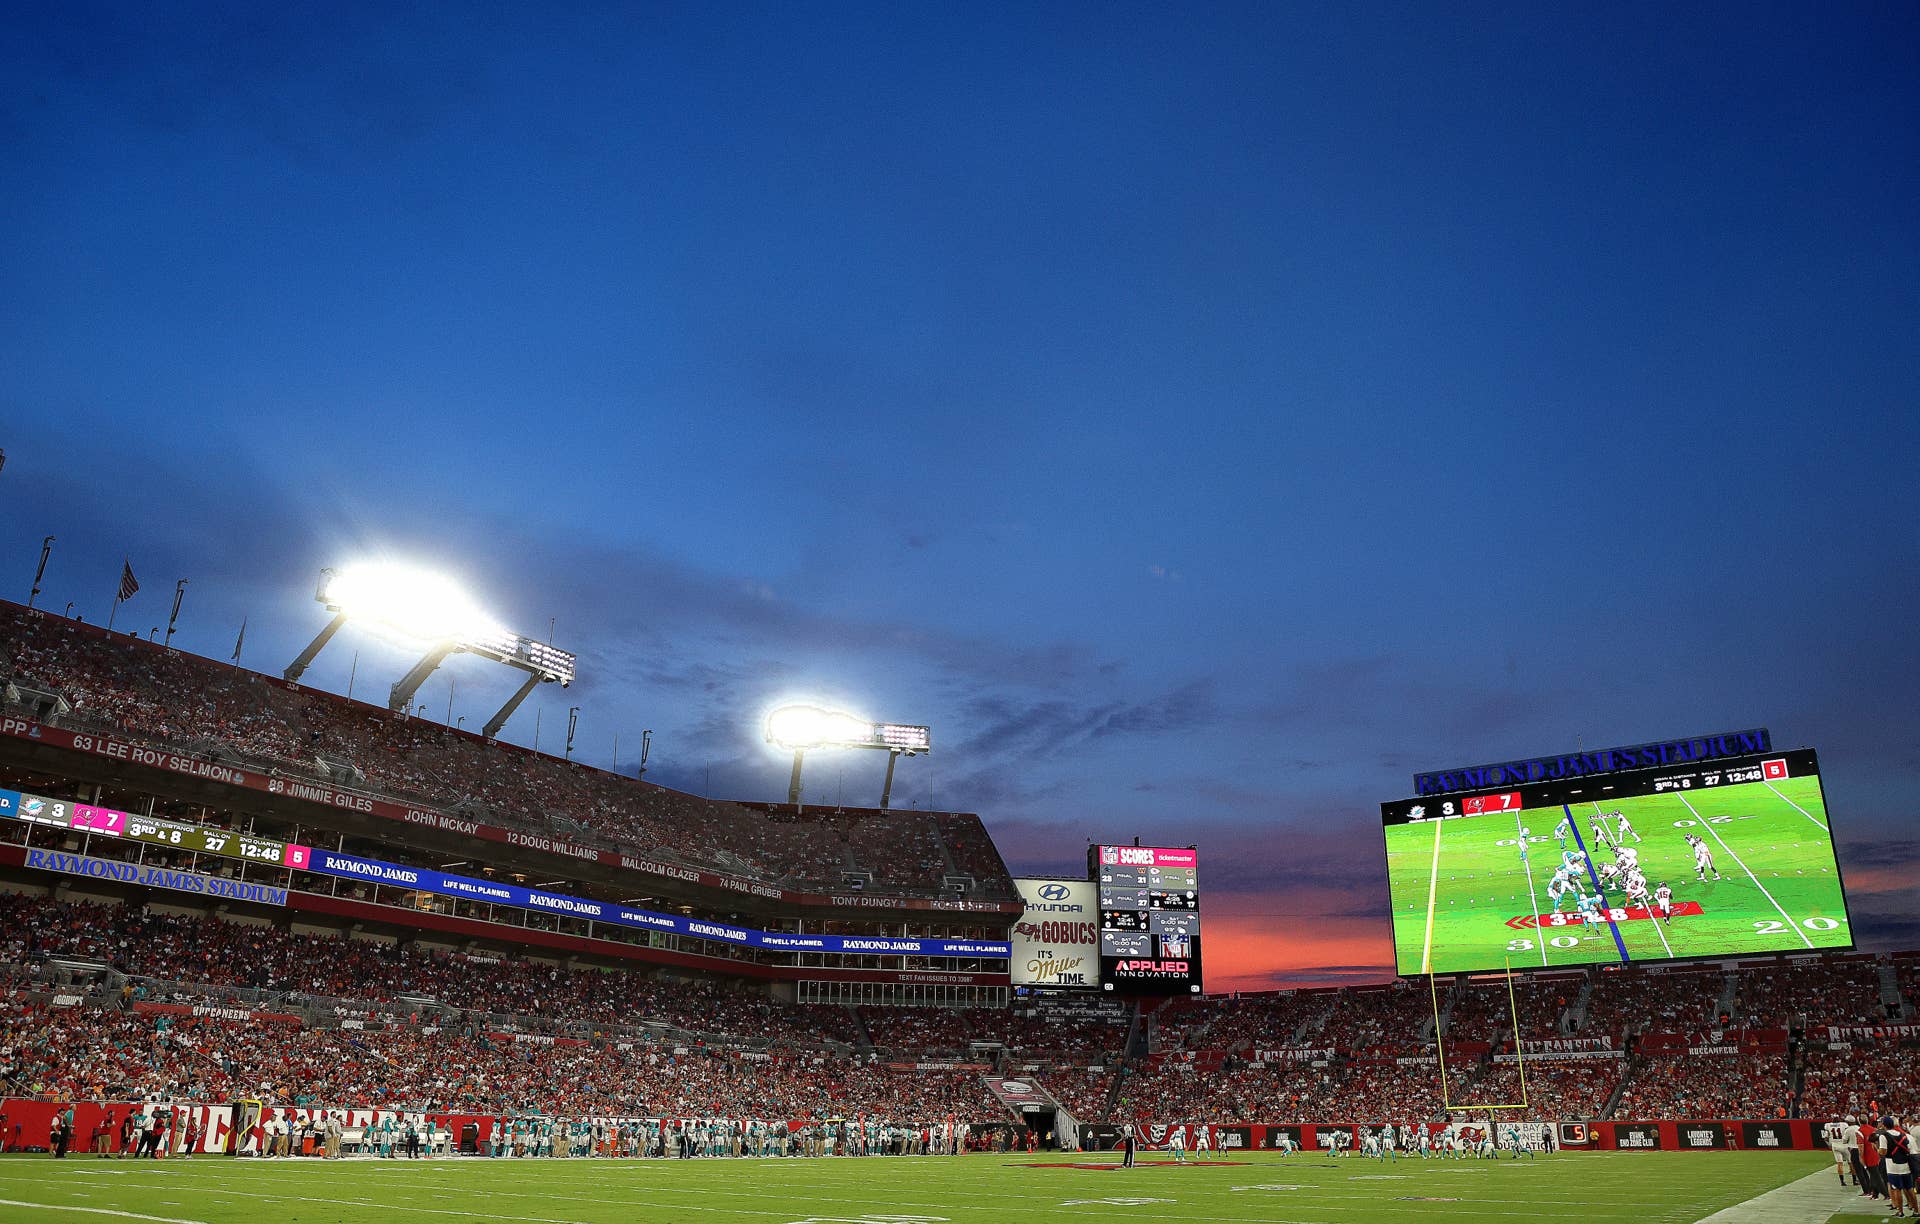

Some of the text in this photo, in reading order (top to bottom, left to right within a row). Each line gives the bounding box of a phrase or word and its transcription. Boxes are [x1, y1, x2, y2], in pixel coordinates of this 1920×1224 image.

[0, 719, 27, 735] PP
[73, 735, 232, 784] 63 LEE ROY SELMON
[1418, 731, 1765, 796] RAYMOND JAMES STADIUM
[1727, 770, 1762, 783] 12:48
[1770, 766, 1779, 775] 5
[1655, 781, 1672, 791] 3RD
[1682, 779, 1691, 788] 8
[1705, 775, 1720, 786] 27
[288, 784, 332, 803] JIMMIE
[336, 794, 373, 812] GILES
[1500, 795, 1512, 808] 7
[52, 804, 65, 817] 3
[1442, 802, 1454, 815] 3
[107, 814, 119, 827] 7
[404, 810, 479, 835] JOHN MCKAY
[130, 823, 182, 844] 3RD & 8
[162, 822, 195, 833] DISTANCE
[203, 830, 219, 838] BALL
[205, 837, 225, 850] 27
[253, 839, 282, 849] QUARTER
[506, 832, 598, 861] 12 DOUG WILLIAMS
[239, 843, 280, 861] 12:48
[293, 851, 303, 863] 5
[1120, 848, 1155, 865] SCORES
[1158, 855, 1193, 863] ticketmaster
[325, 857, 417, 883] RAYMOND JAMES
[621, 857, 700, 882] MALCOLM GLAZER
[27, 850, 286, 905] RAYMOND JAMES STADIUM
[443, 880, 458, 890] LIFE
[459, 884, 477, 893] WELL
[720, 878, 782, 899] 74 PAUL GRUBER
[529, 894, 601, 915] RAYMOND JAMES
[831, 896, 898, 907] TONY DUNGY
[1026, 904, 1082, 912] HYUNDAI
[1102, 898, 1113, 906] 24
[1138, 899, 1148, 907] 27
[621, 912, 633, 920] LIFE
[633, 915, 648, 923] WELL
[1608, 908, 1629, 921] 8
[689, 923, 747, 941] RAYMOND JAMES
[1140, 922, 1147, 930] 0
[1033, 921, 1097, 945] #GOBUCS
[843, 940, 921, 951] RAYMOND JAMES
[1037, 951, 1053, 959] IT'S
[1027, 957, 1085, 981] Miller
[1115, 960, 1189, 972] APPLIED
[1057, 973, 1085, 984] TIME
[1574, 1126, 1584, 1140] 5
[1758, 1130, 1775, 1138] TEAM
[1831, 1128, 1843, 1139] 11
[1620, 1139, 1629, 1147] END
